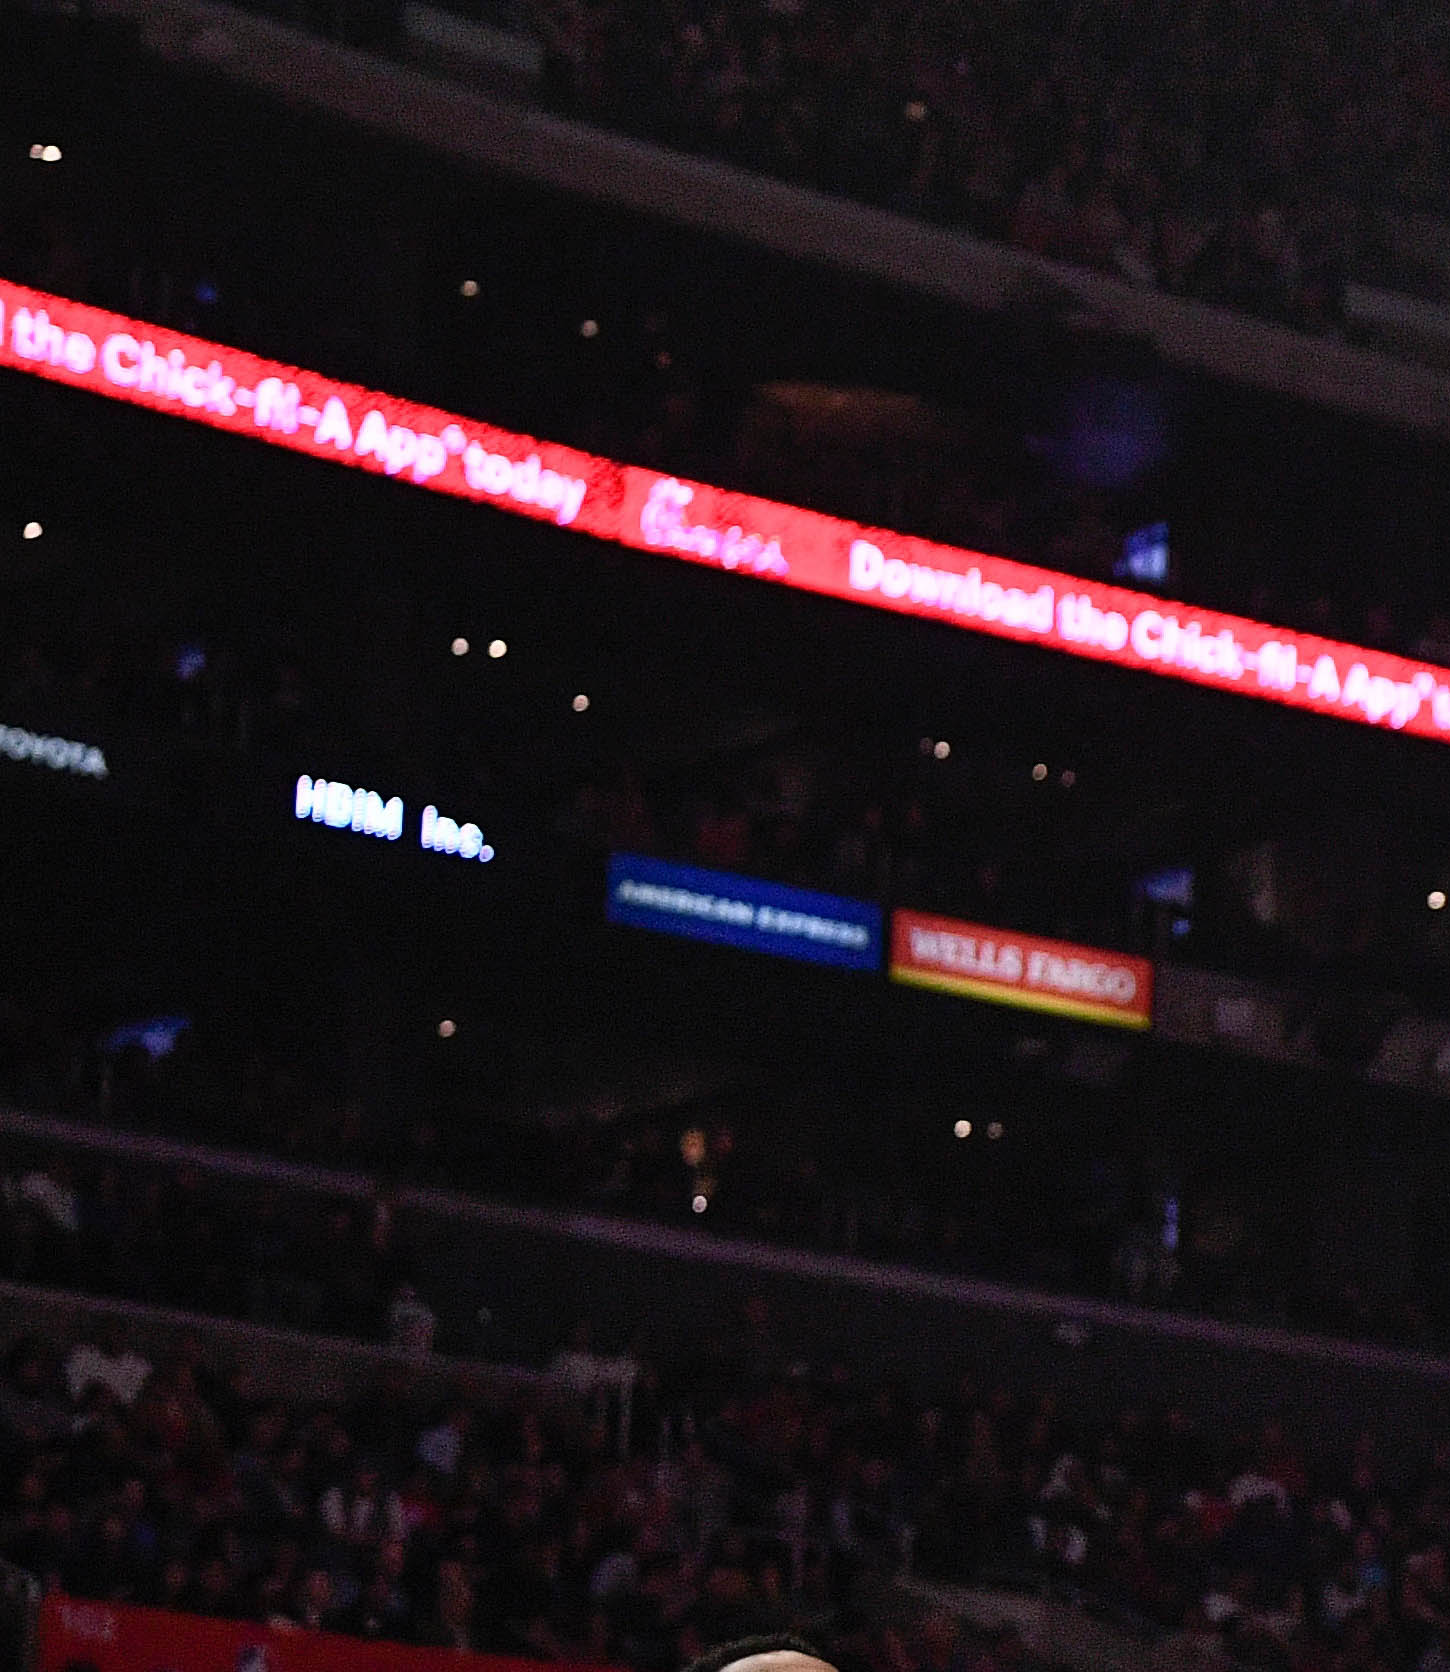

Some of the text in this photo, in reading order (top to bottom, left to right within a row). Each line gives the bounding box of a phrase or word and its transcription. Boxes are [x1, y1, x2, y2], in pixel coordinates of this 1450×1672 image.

[12, 306, 97, 374] the
[462, 440, 587, 526] today
[849, 539, 1055, 634] Download
[1057, 593, 1129, 650] the
